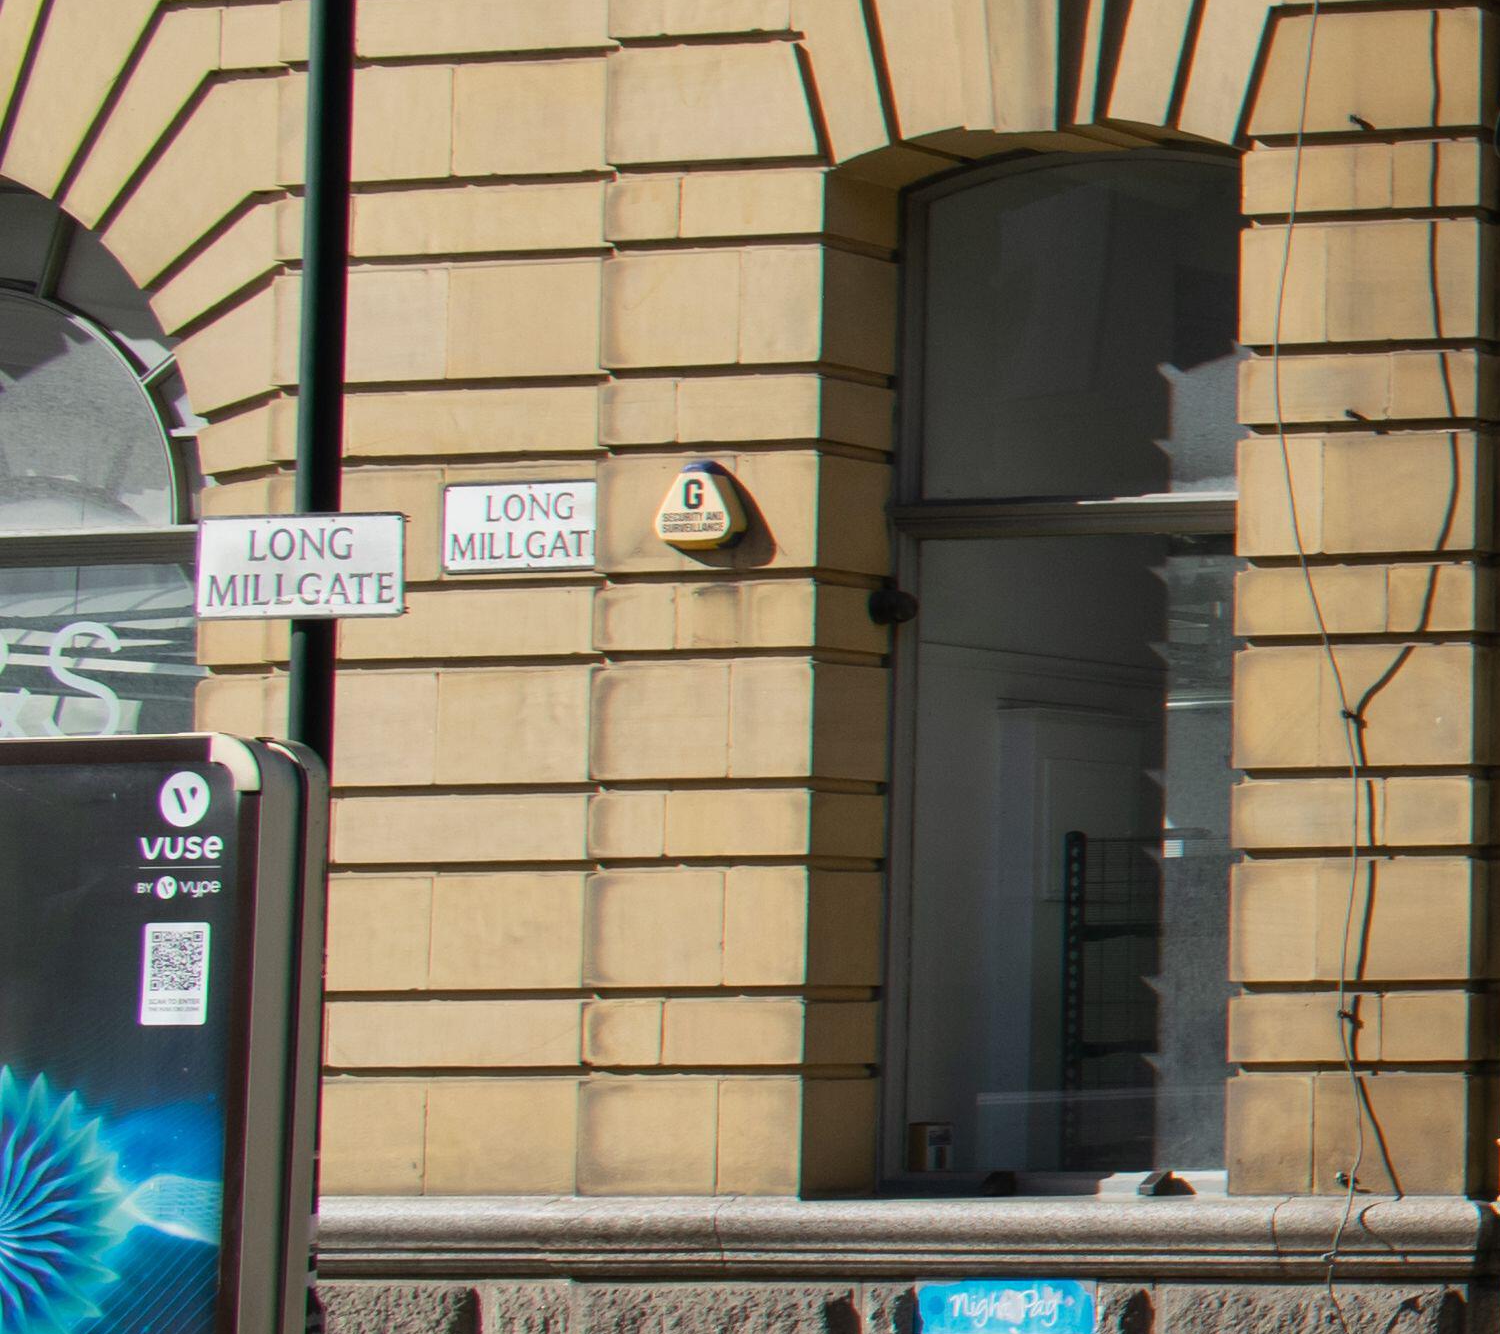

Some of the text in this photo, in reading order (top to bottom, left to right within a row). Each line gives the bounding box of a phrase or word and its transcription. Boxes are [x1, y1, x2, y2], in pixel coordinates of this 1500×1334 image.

[486, 492, 575, 522] LONG
[684, 479, 704, 509] G
[662, 511, 724, 522] SECURITY AND
[662, 521, 724, 533] SURVEILLANCE
[248, 527, 353, 562] LONG
[450, 529, 595, 561] MILLGAT
[206, 571, 394, 607] MILLGATE
[140, 835, 224, 860] vuse
[137, 878, 222, 897] BY vype
